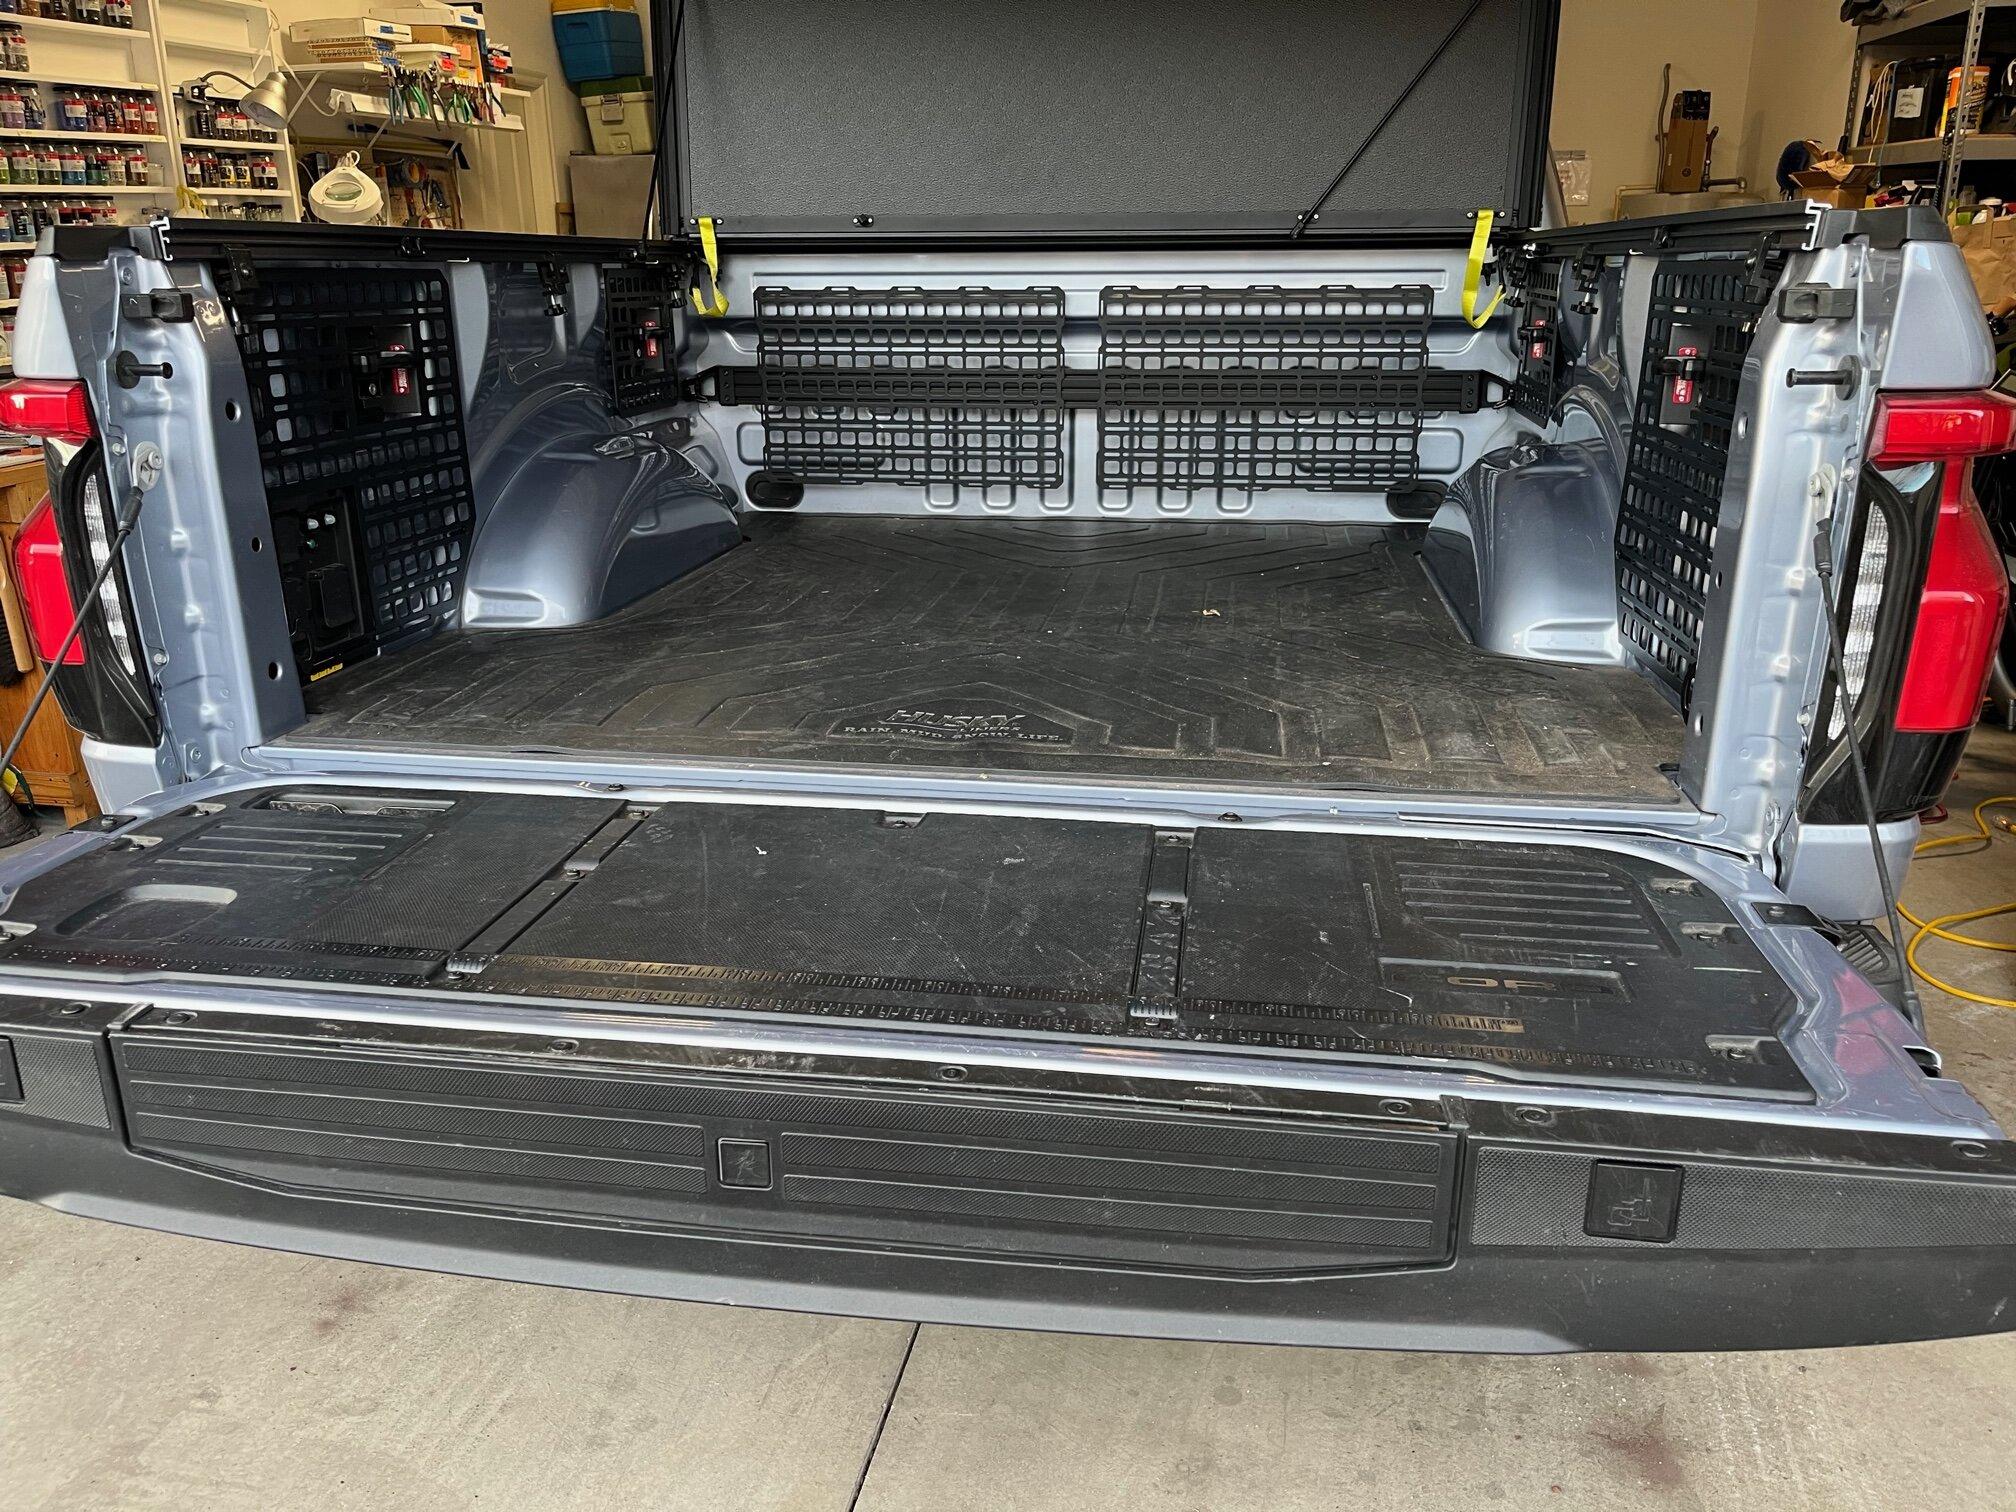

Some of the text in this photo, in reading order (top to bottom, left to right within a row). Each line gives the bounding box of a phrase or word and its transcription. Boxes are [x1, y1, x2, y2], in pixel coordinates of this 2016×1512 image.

[886, 709, 1026, 727] HUSKY
[900, 728, 946, 739] MUD.
[1017, 733, 1063, 741] LIFE.
